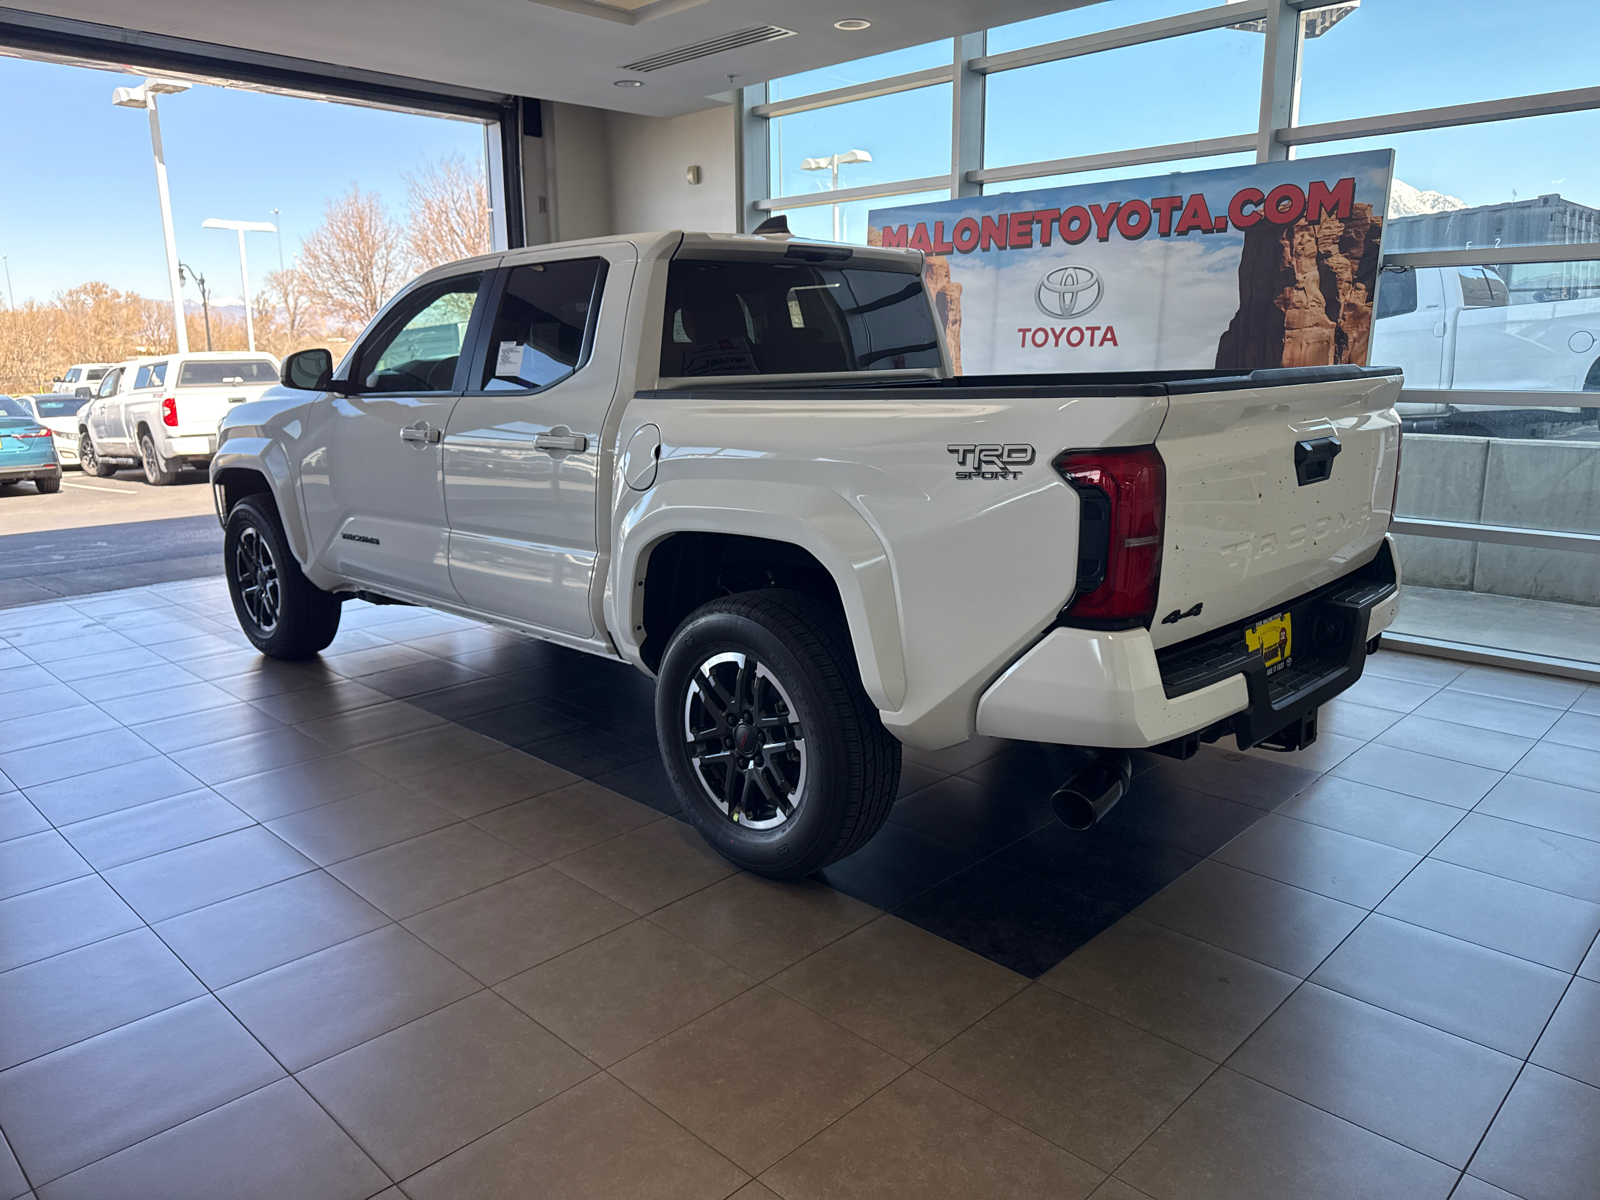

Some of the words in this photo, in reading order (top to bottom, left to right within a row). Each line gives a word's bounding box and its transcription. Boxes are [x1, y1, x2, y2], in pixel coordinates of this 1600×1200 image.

[882, 177, 1356, 256] MALONETOYOTA.COM
[1017, 325, 1119, 348] TOYOTA
[947, 443, 1036, 472] TRD
[955, 471, 1023, 480] SPORT
